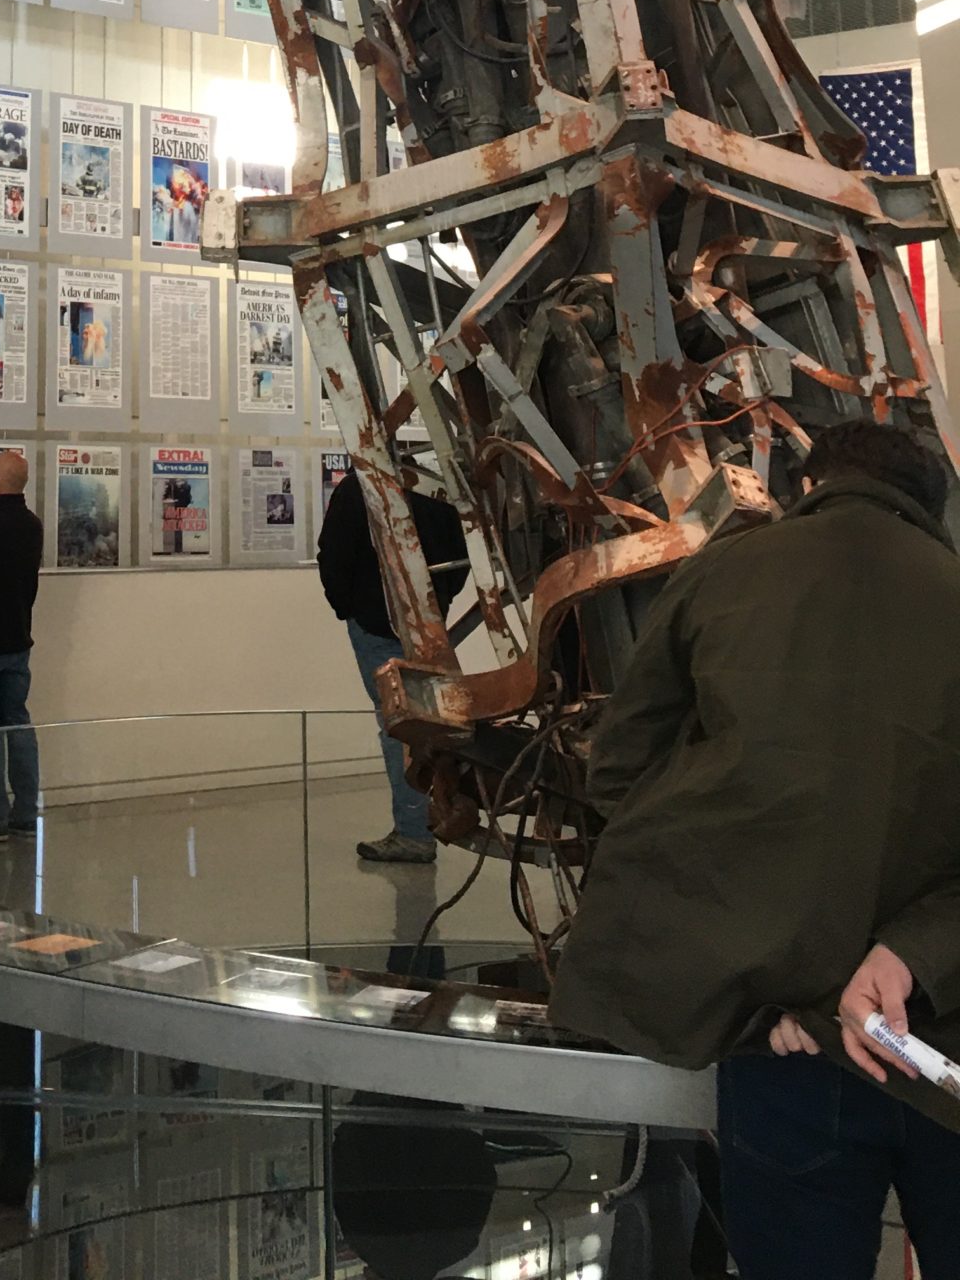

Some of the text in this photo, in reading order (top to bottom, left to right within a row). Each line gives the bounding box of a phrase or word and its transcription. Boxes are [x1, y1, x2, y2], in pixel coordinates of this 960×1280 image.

[62, 121, 121, 143] DAY OF DEATH
[152, 137, 209, 164] BASTARDS!
[59, 287, 121, 307] A day of infamy
[240, 286, 291, 301] Detroit Press
[246, 301, 286, 314] AMERICA'S
[240, 311, 291, 326] DARKEST DAY
[158, 449, 204, 461] EXTRA!
[325, 455, 345, 469] USA
[71, 467, 120, 478] LIKE WAR ZONE
[156, 463, 209, 475] Newsday
[872, 1028, 922, 1073] INFORMATION
